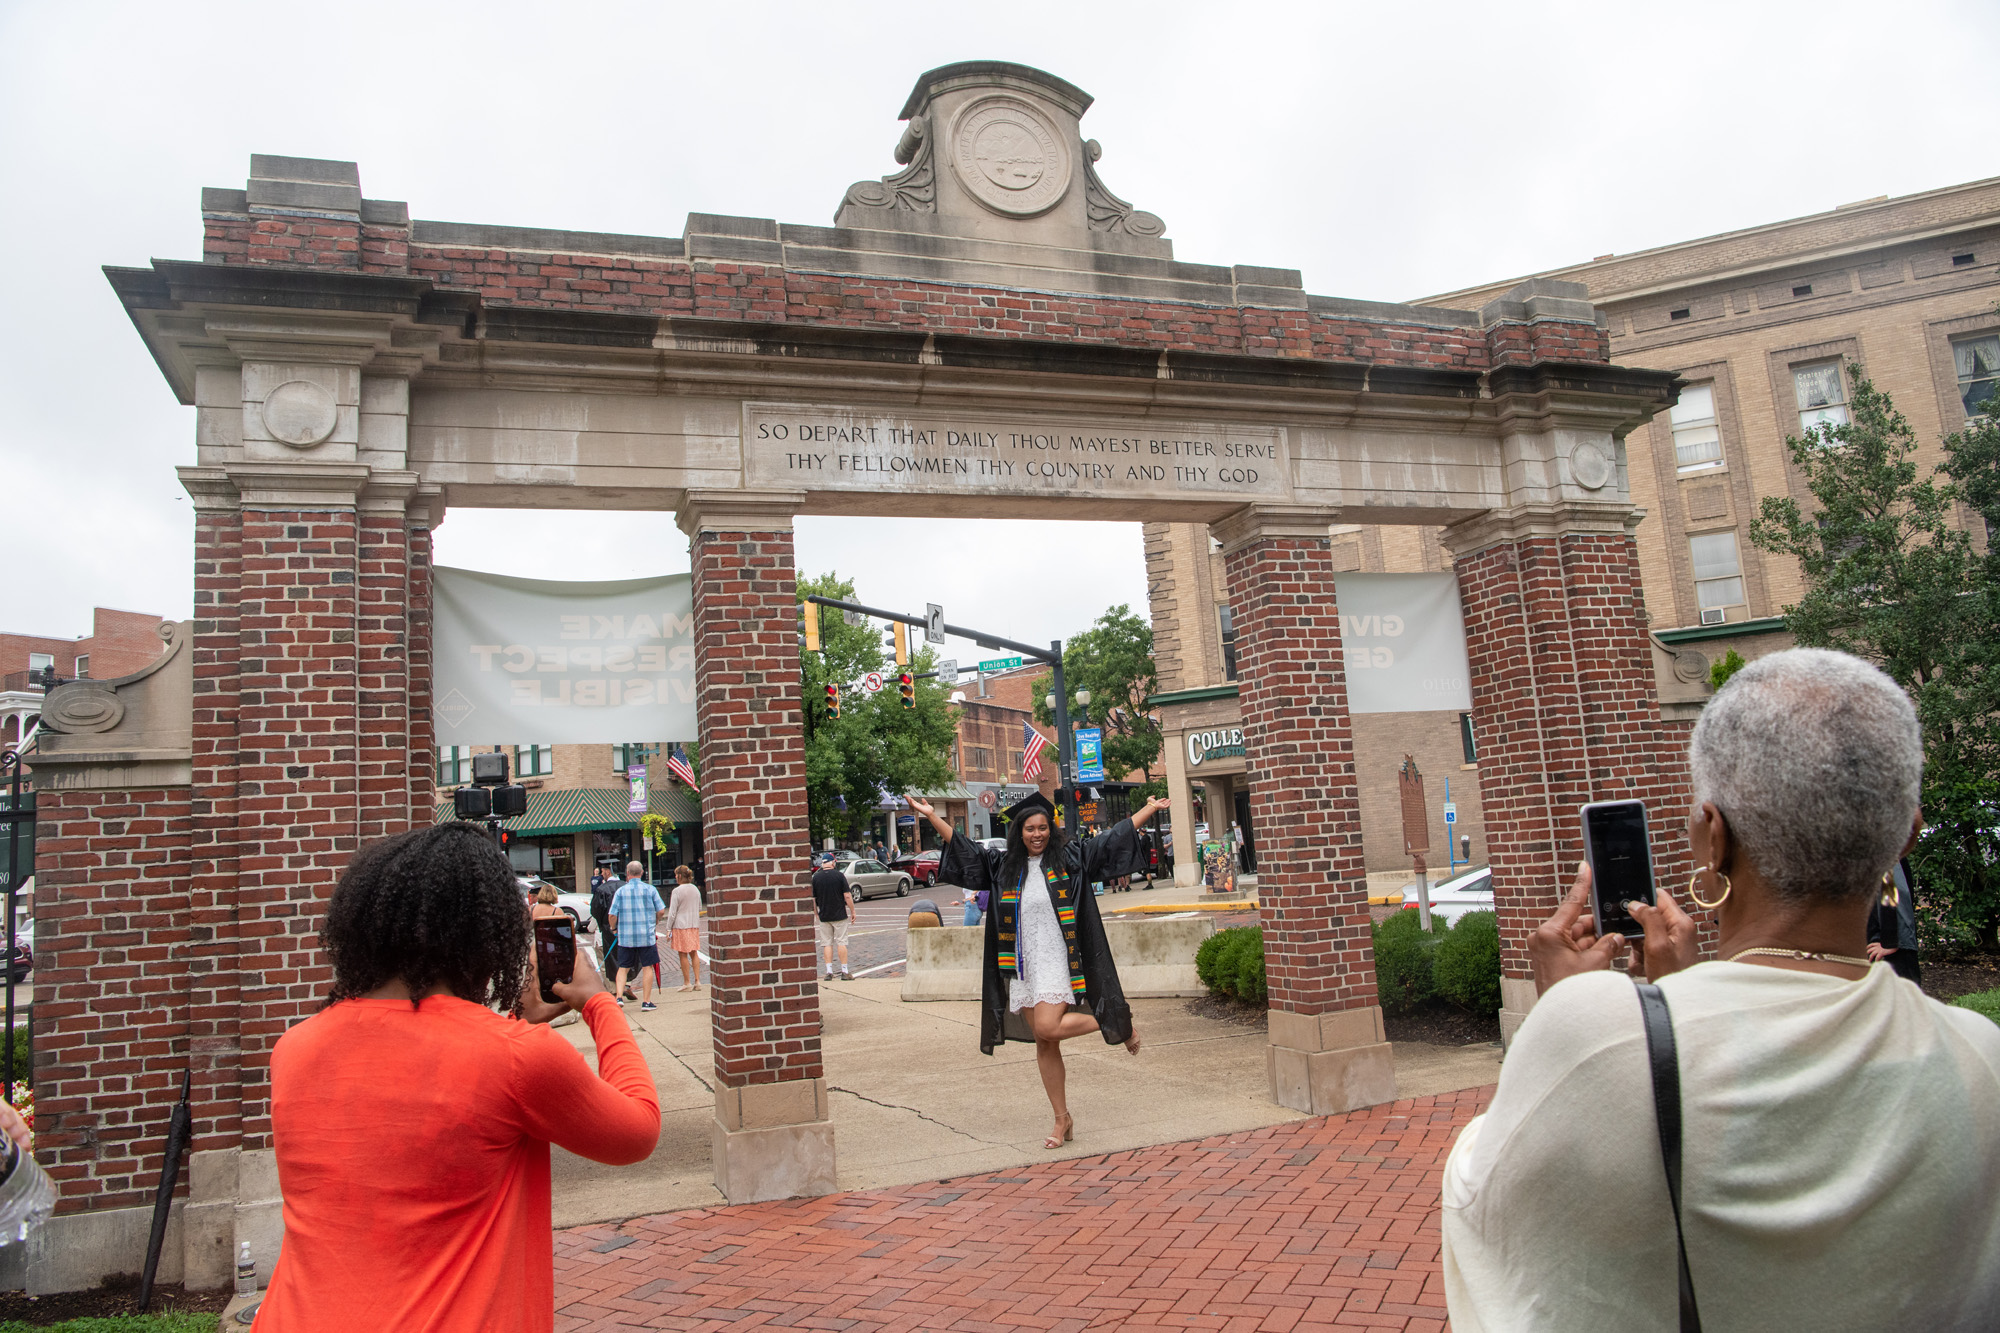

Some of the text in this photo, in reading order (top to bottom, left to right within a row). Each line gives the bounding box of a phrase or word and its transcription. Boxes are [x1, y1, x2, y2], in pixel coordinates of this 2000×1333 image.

[1797, 371, 1821, 380] Center
[758, 424, 1276, 459] SO DEPART THAT DAILY THOU MAYEST BETTER SERVE
[786, 453, 1258, 483] THY FELLOWMEN THY COUNTRY AND THY GOD
[931, 632, 942, 641] ONLY
[984, 661, 1006, 670] Union
[1188, 728, 1246, 766] COLLE
[999, 790, 1027, 799] CHIPOTLE
[1064, 930, 1076, 940] LASS
